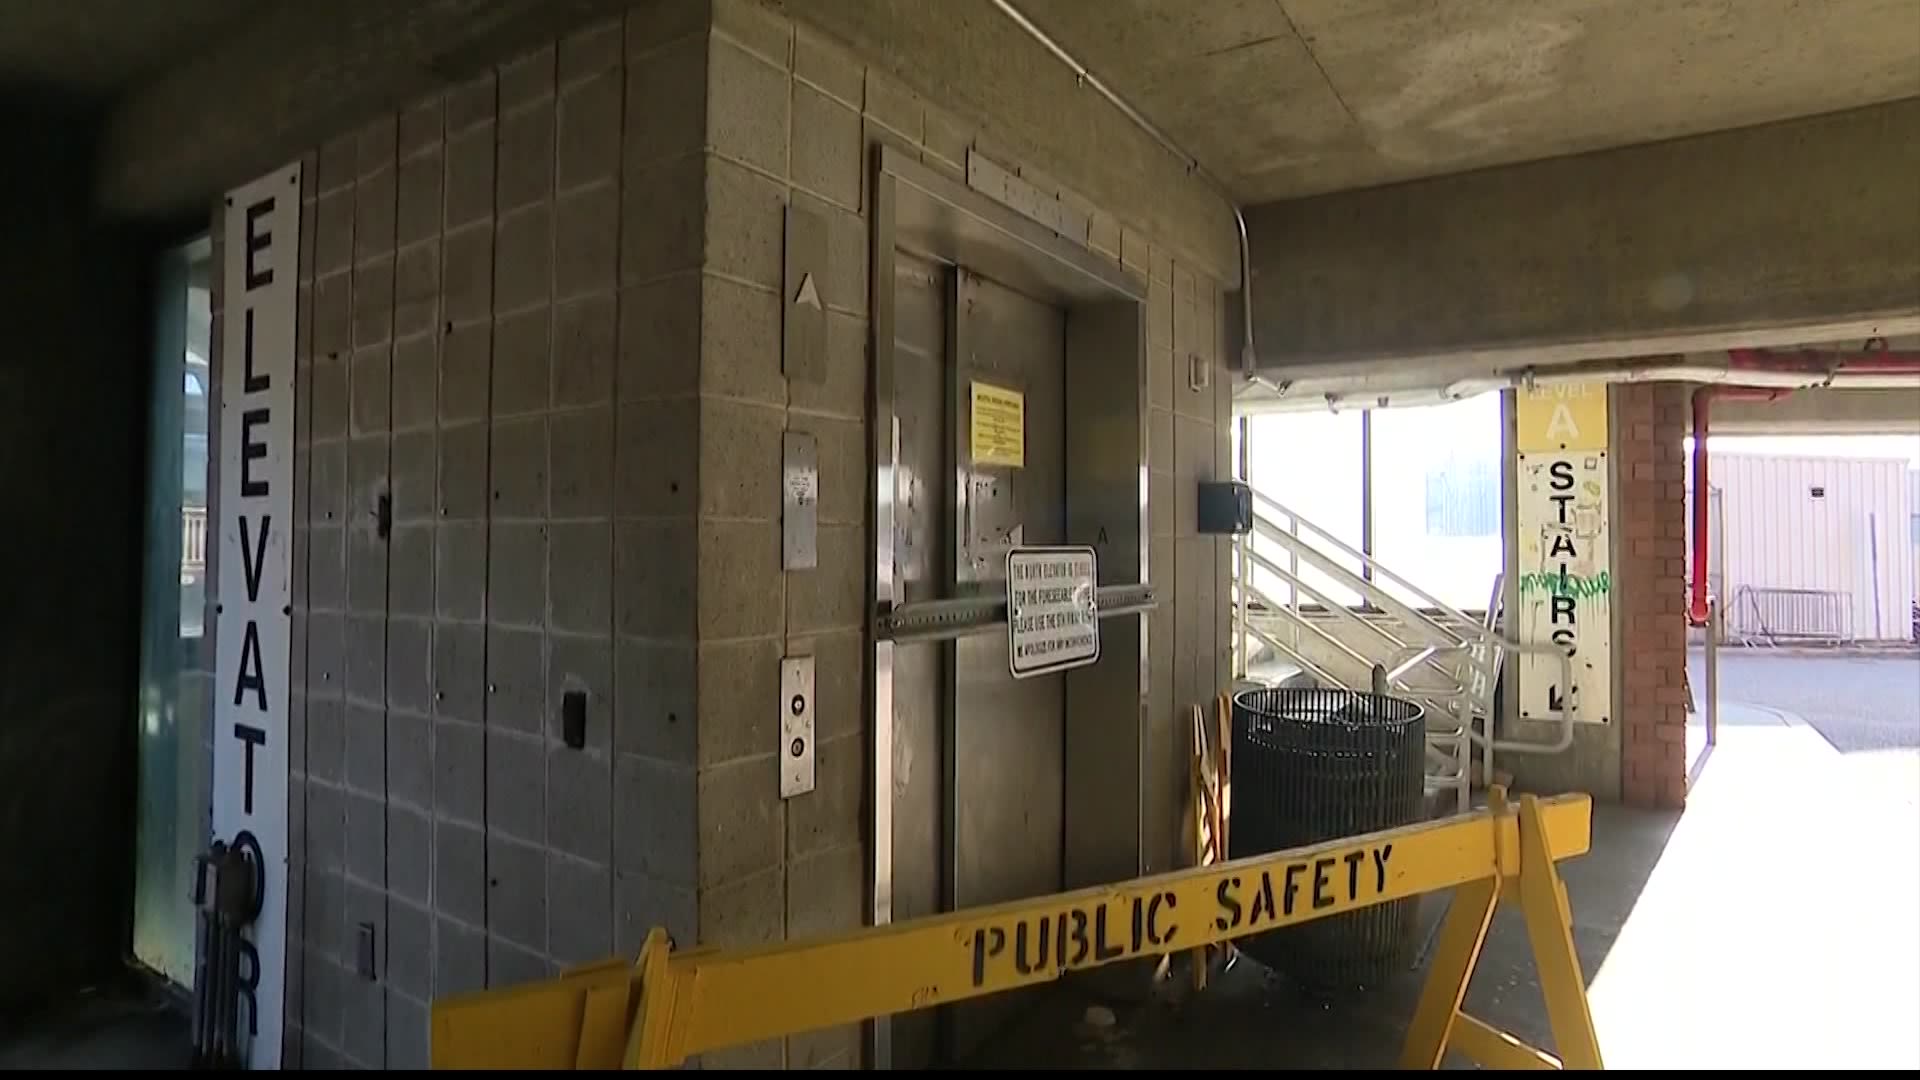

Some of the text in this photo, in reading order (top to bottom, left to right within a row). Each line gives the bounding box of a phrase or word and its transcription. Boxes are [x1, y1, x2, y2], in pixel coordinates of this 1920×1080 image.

[1546, 404, 1580, 440] A
[232, 196, 276, 1036] ELEVATOR
[1549, 461, 1577, 658] STAIRS
[973, 844, 1392, 987] PUBLIC SAFETY
